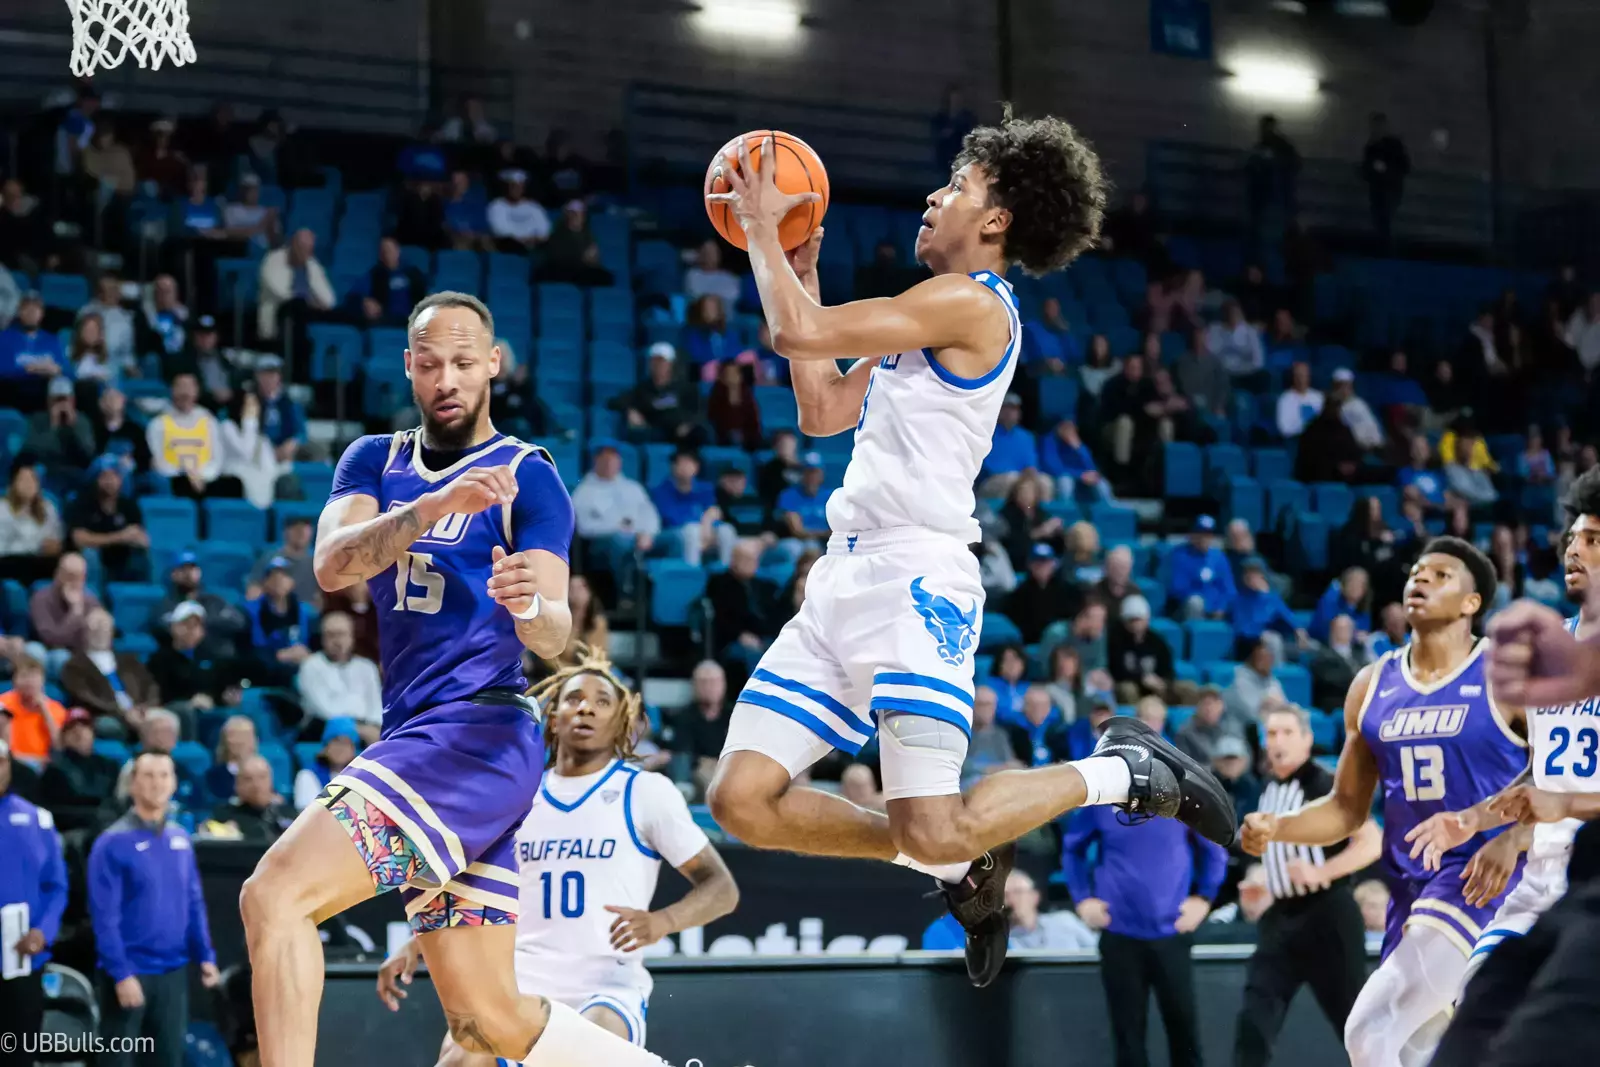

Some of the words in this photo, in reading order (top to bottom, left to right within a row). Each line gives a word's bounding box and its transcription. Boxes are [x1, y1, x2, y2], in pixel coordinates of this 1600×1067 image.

[392, 551, 446, 615] 15
[1381, 705, 1467, 740] JMU
[1400, 744, 1447, 802] 13
[1545, 726, 1599, 778] 23
[520, 838, 616, 862] BUFFALO
[540, 870, 585, 919] 10
